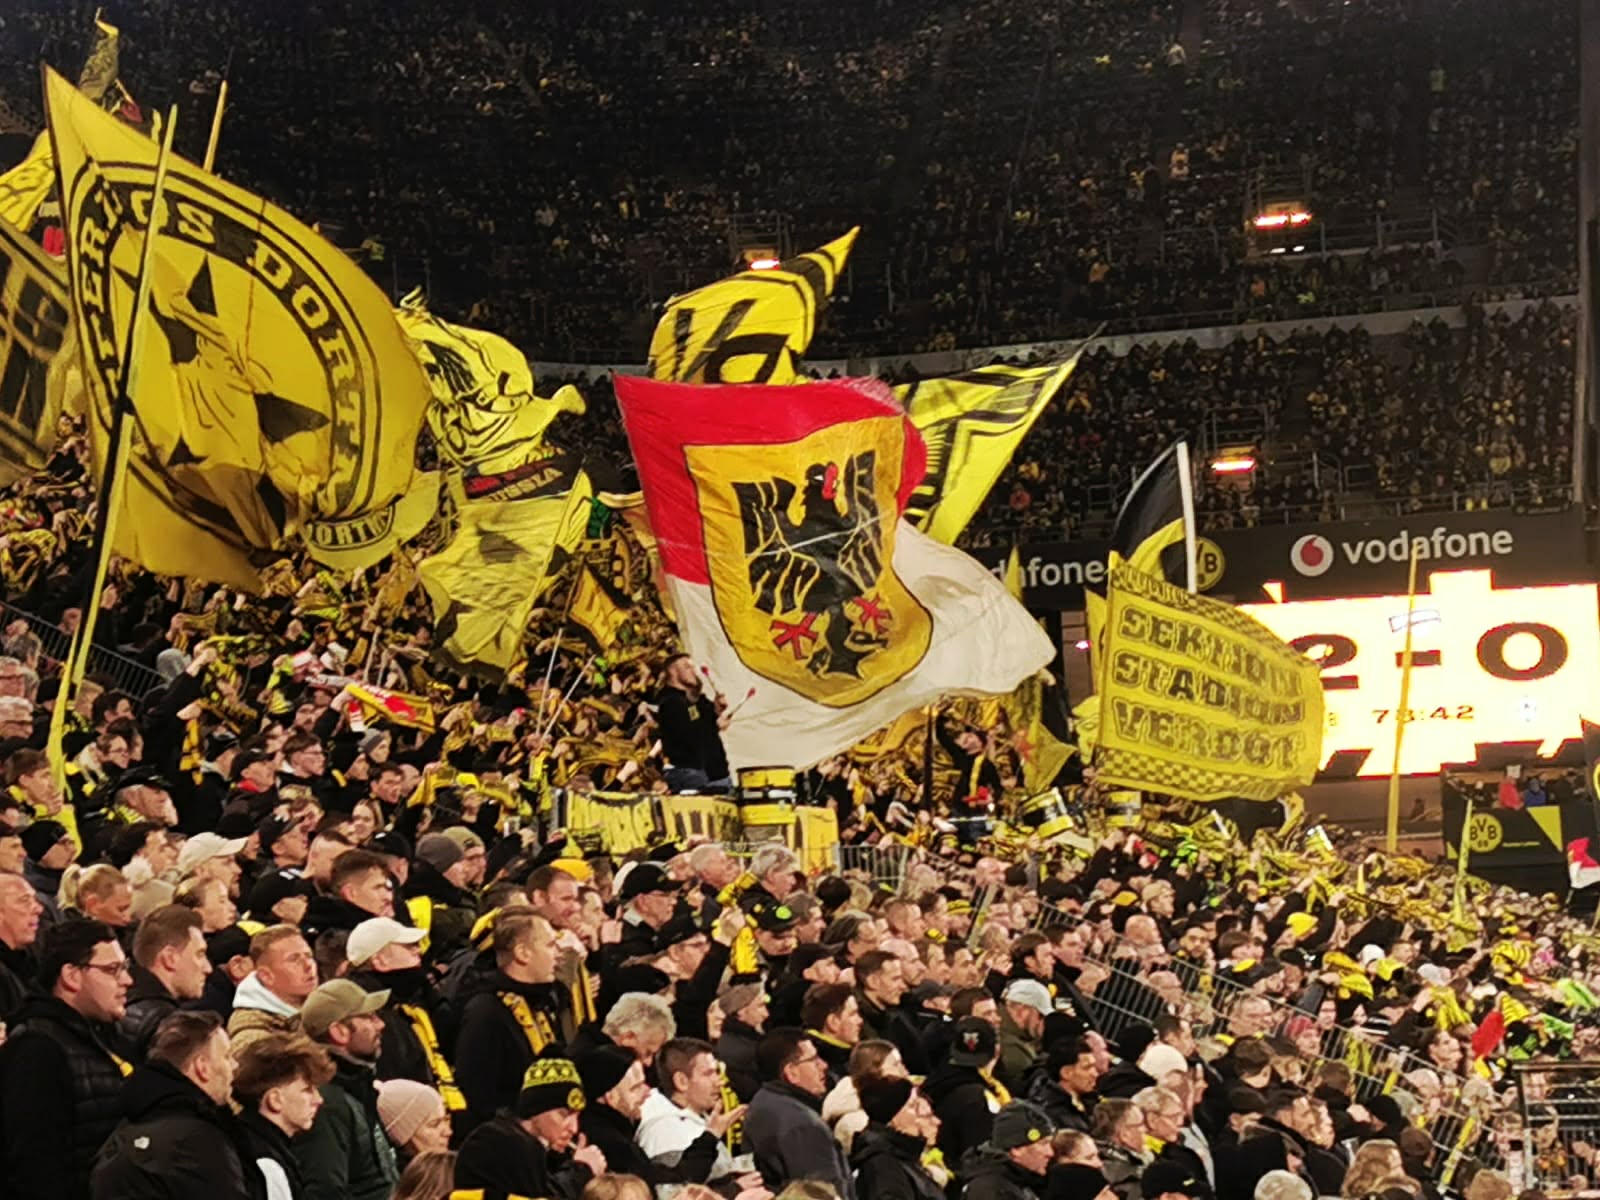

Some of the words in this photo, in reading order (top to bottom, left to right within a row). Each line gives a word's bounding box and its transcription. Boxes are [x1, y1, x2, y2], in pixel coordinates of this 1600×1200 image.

[1342, 526, 1514, 565] vodafone
[1476, 621, 1569, 681] 0
[1113, 650, 1305, 727] STADION
[1111, 696, 1305, 770] VERBOT
